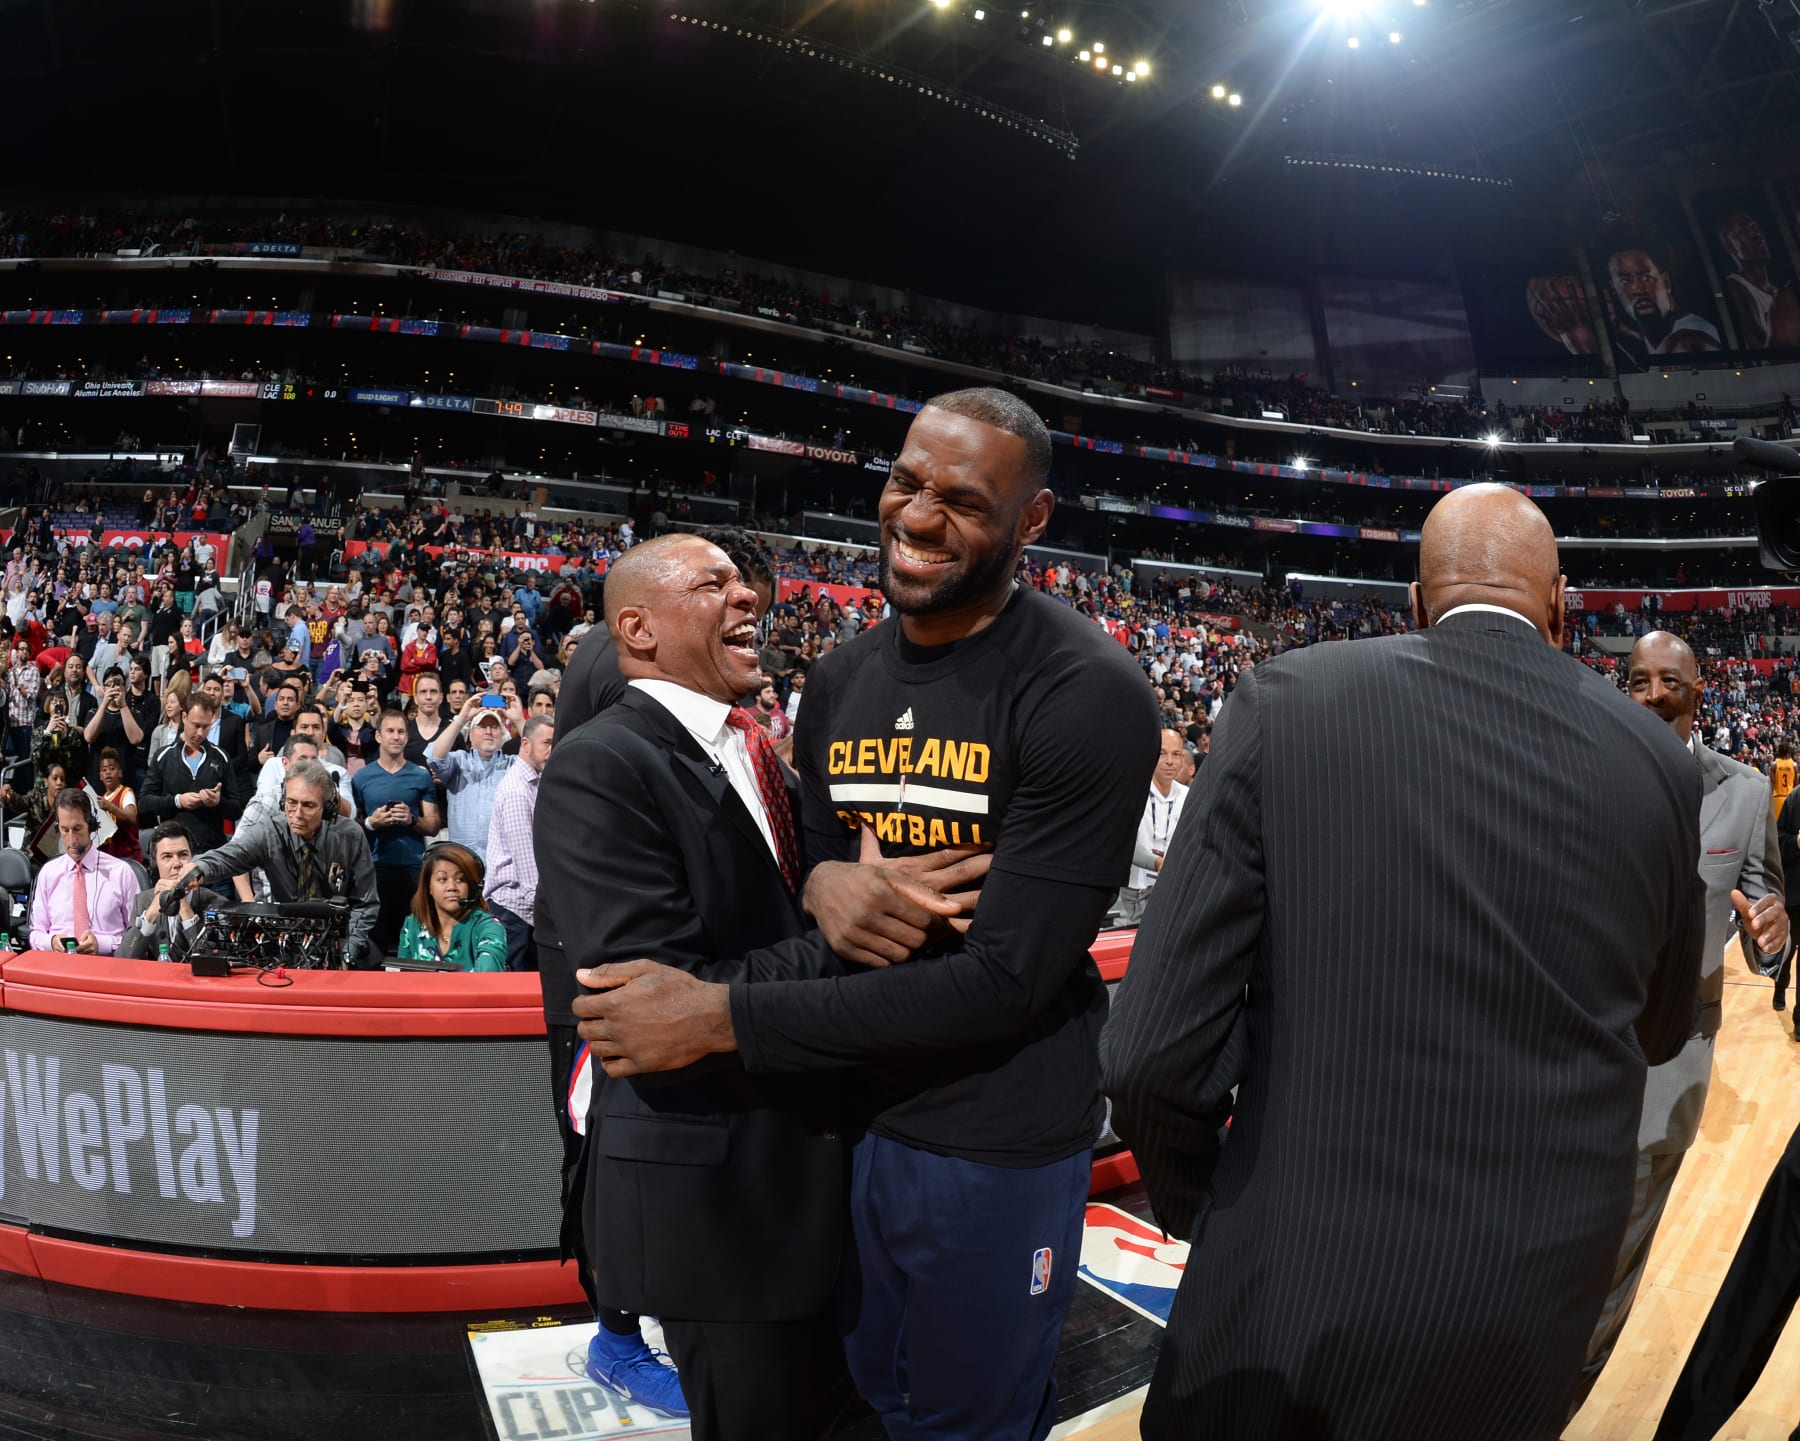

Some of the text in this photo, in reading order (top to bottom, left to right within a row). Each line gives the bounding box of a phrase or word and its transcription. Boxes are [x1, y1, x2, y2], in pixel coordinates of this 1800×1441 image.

[262, 245, 296, 253] DELTA
[579, 289, 608, 301] 69050
[26, 382, 66, 394] StubHub
[84, 382, 135, 391] Ohio University
[203, 384, 258, 395] OSHIBA
[264, 384, 280, 392] CLE
[375, 394, 400, 402] LIGHT
[426, 397, 470, 409] DELTA
[706, 428, 741, 440] LAC CLE
[806, 446, 858, 465] TOYOTA
[873, 456, 890, 466] Ohio
[863, 462, 889, 473] Alumni
[1661, 488, 1696, 497] TOYOTA
[271, 515, 292, 526] SAN
[1216, 514, 1250, 527] StubHub
[1360, 528, 1399, 541] TOSHIBA
[828, 737, 990, 783] CLEVELAND
[1782, 774, 1788, 787] 3
[0, 1049, 260, 1238] WePlay
[531, 1320, 562, 1328] Custom
